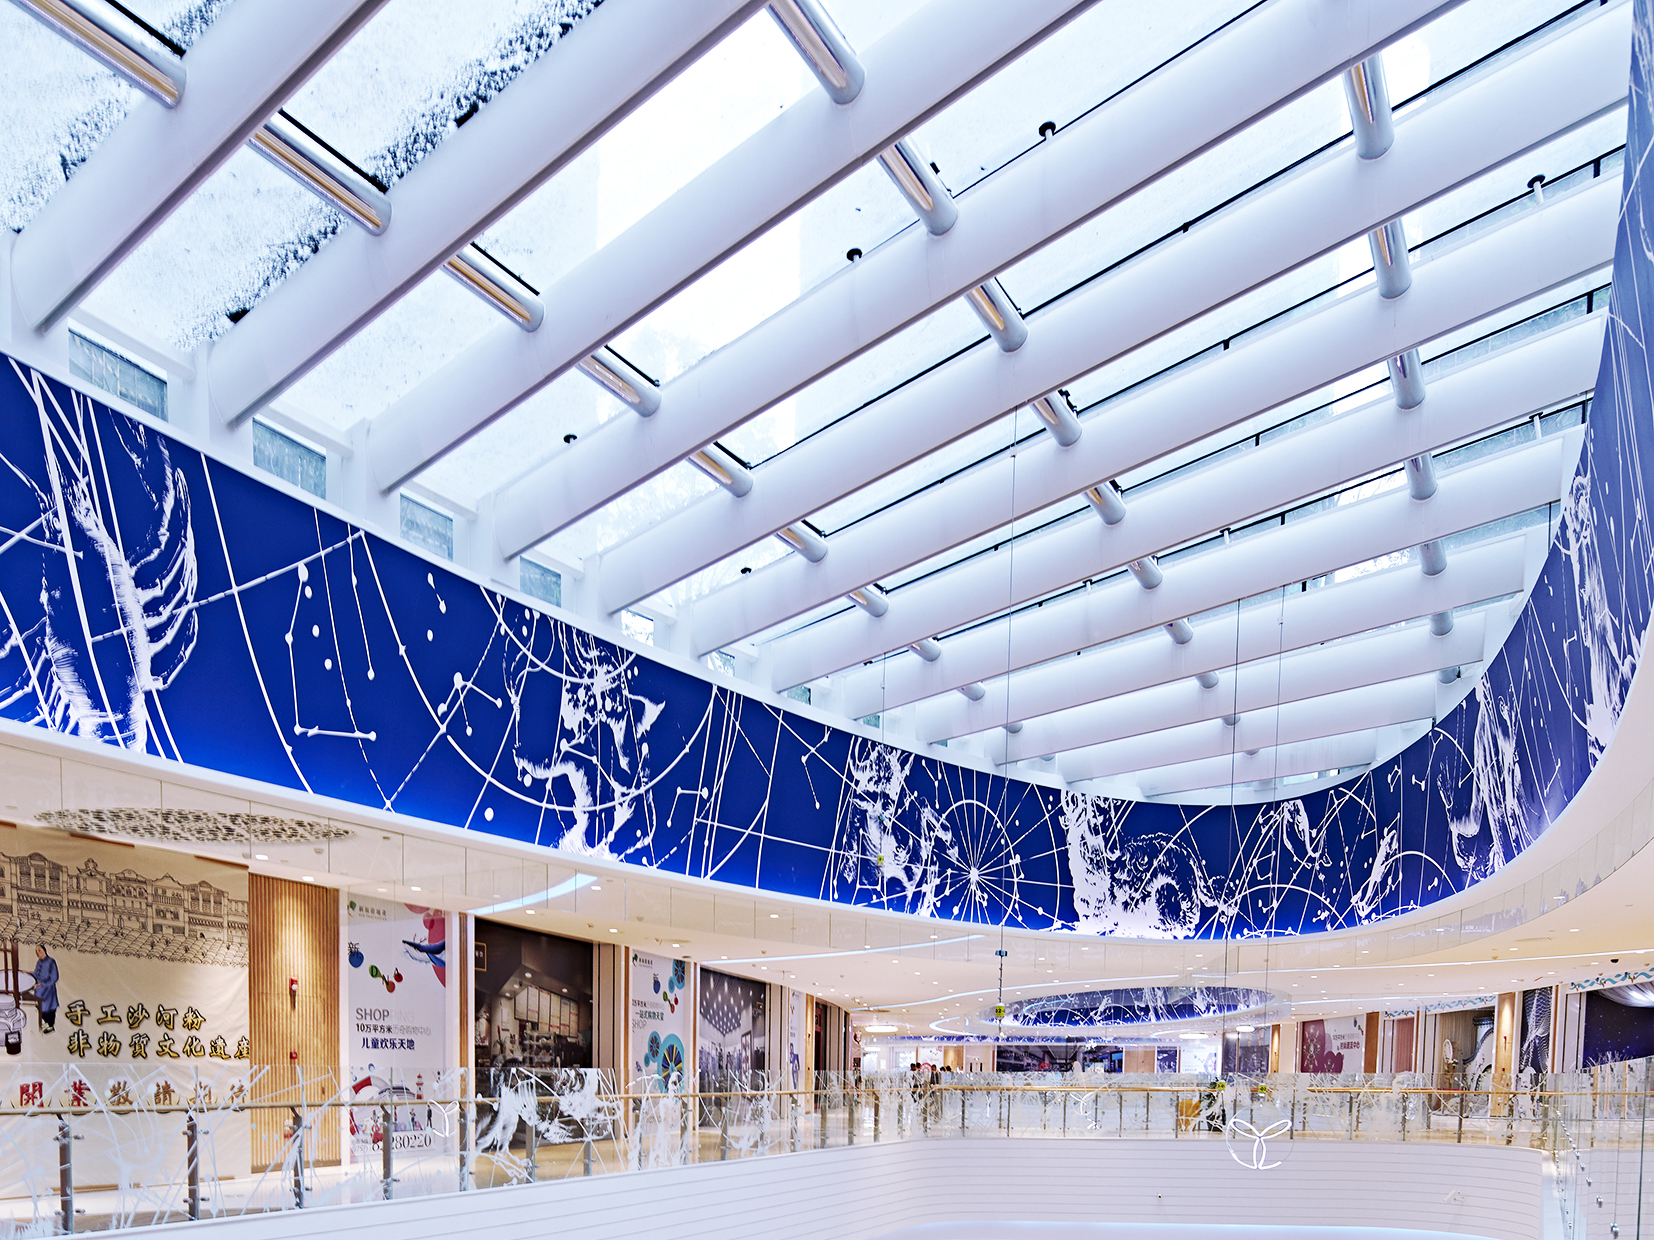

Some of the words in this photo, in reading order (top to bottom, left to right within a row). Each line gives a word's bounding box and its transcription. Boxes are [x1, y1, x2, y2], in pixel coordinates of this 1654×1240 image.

[65, 999, 206, 1031] 手工沙河粉
[361, 1036, 415, 1050] 儿童欢乐天地
